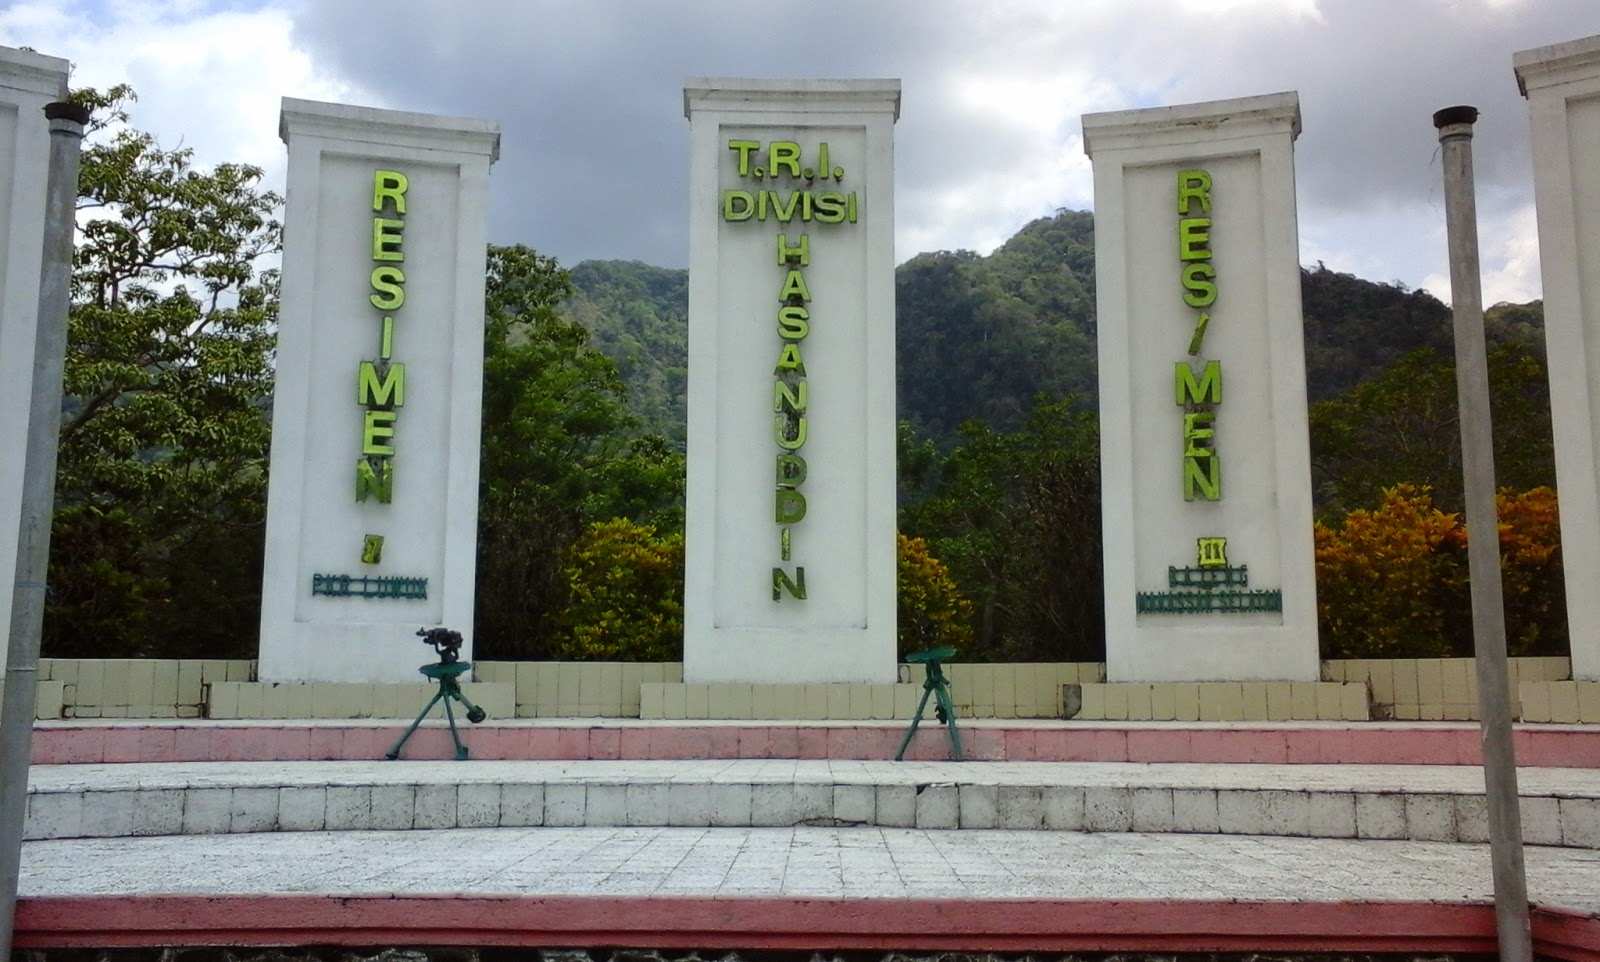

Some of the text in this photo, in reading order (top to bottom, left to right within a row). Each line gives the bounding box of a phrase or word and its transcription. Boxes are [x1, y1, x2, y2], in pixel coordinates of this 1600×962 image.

[723, 189, 857, 224] DIVISI
[729, 139, 844, 181] T.R.I.
[356, 169, 409, 504] RESIMEN
[772, 233, 812, 602] HASANUDDIN
[1175, 169, 1227, 567] RESIMEN III
